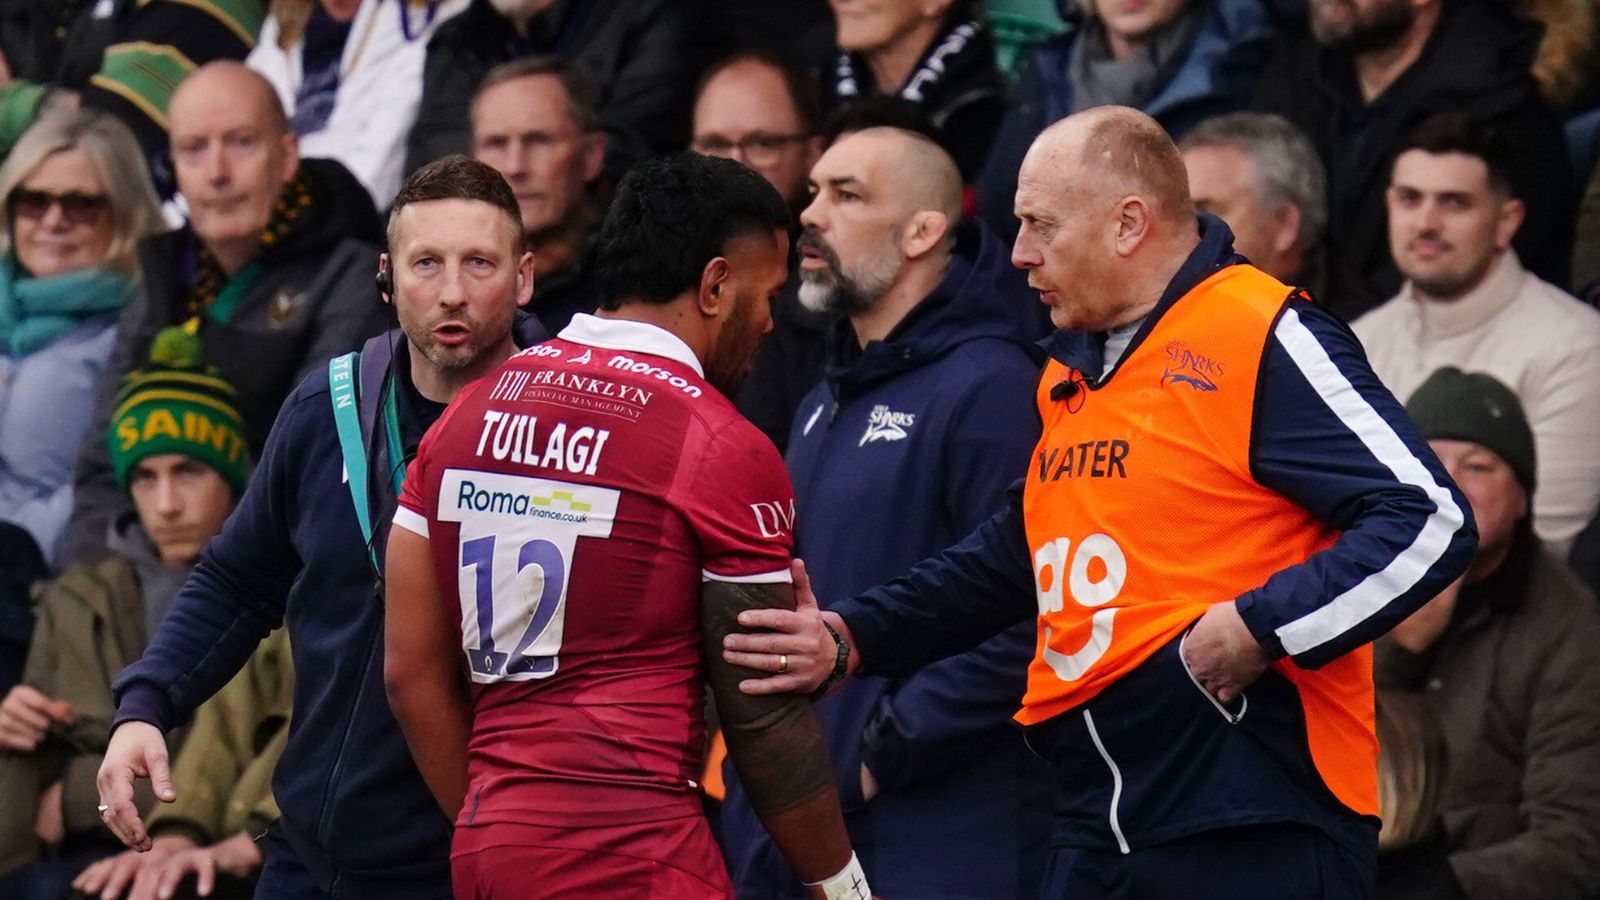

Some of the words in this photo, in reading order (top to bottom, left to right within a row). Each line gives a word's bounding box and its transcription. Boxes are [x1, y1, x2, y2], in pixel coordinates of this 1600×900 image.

[608, 355, 703, 398] morson
[1166, 346, 1225, 376] SHARKS
[523, 389, 567, 403] FINANCIAL
[572, 396, 643, 418] MANAGEMENT
[532, 370, 653, 405] FRANKLYN
[475, 409, 610, 476] TUILAGI
[457, 480, 530, 515] Roma
[529, 507, 588, 523] finance.co.uk
[461, 534, 566, 676] 12
